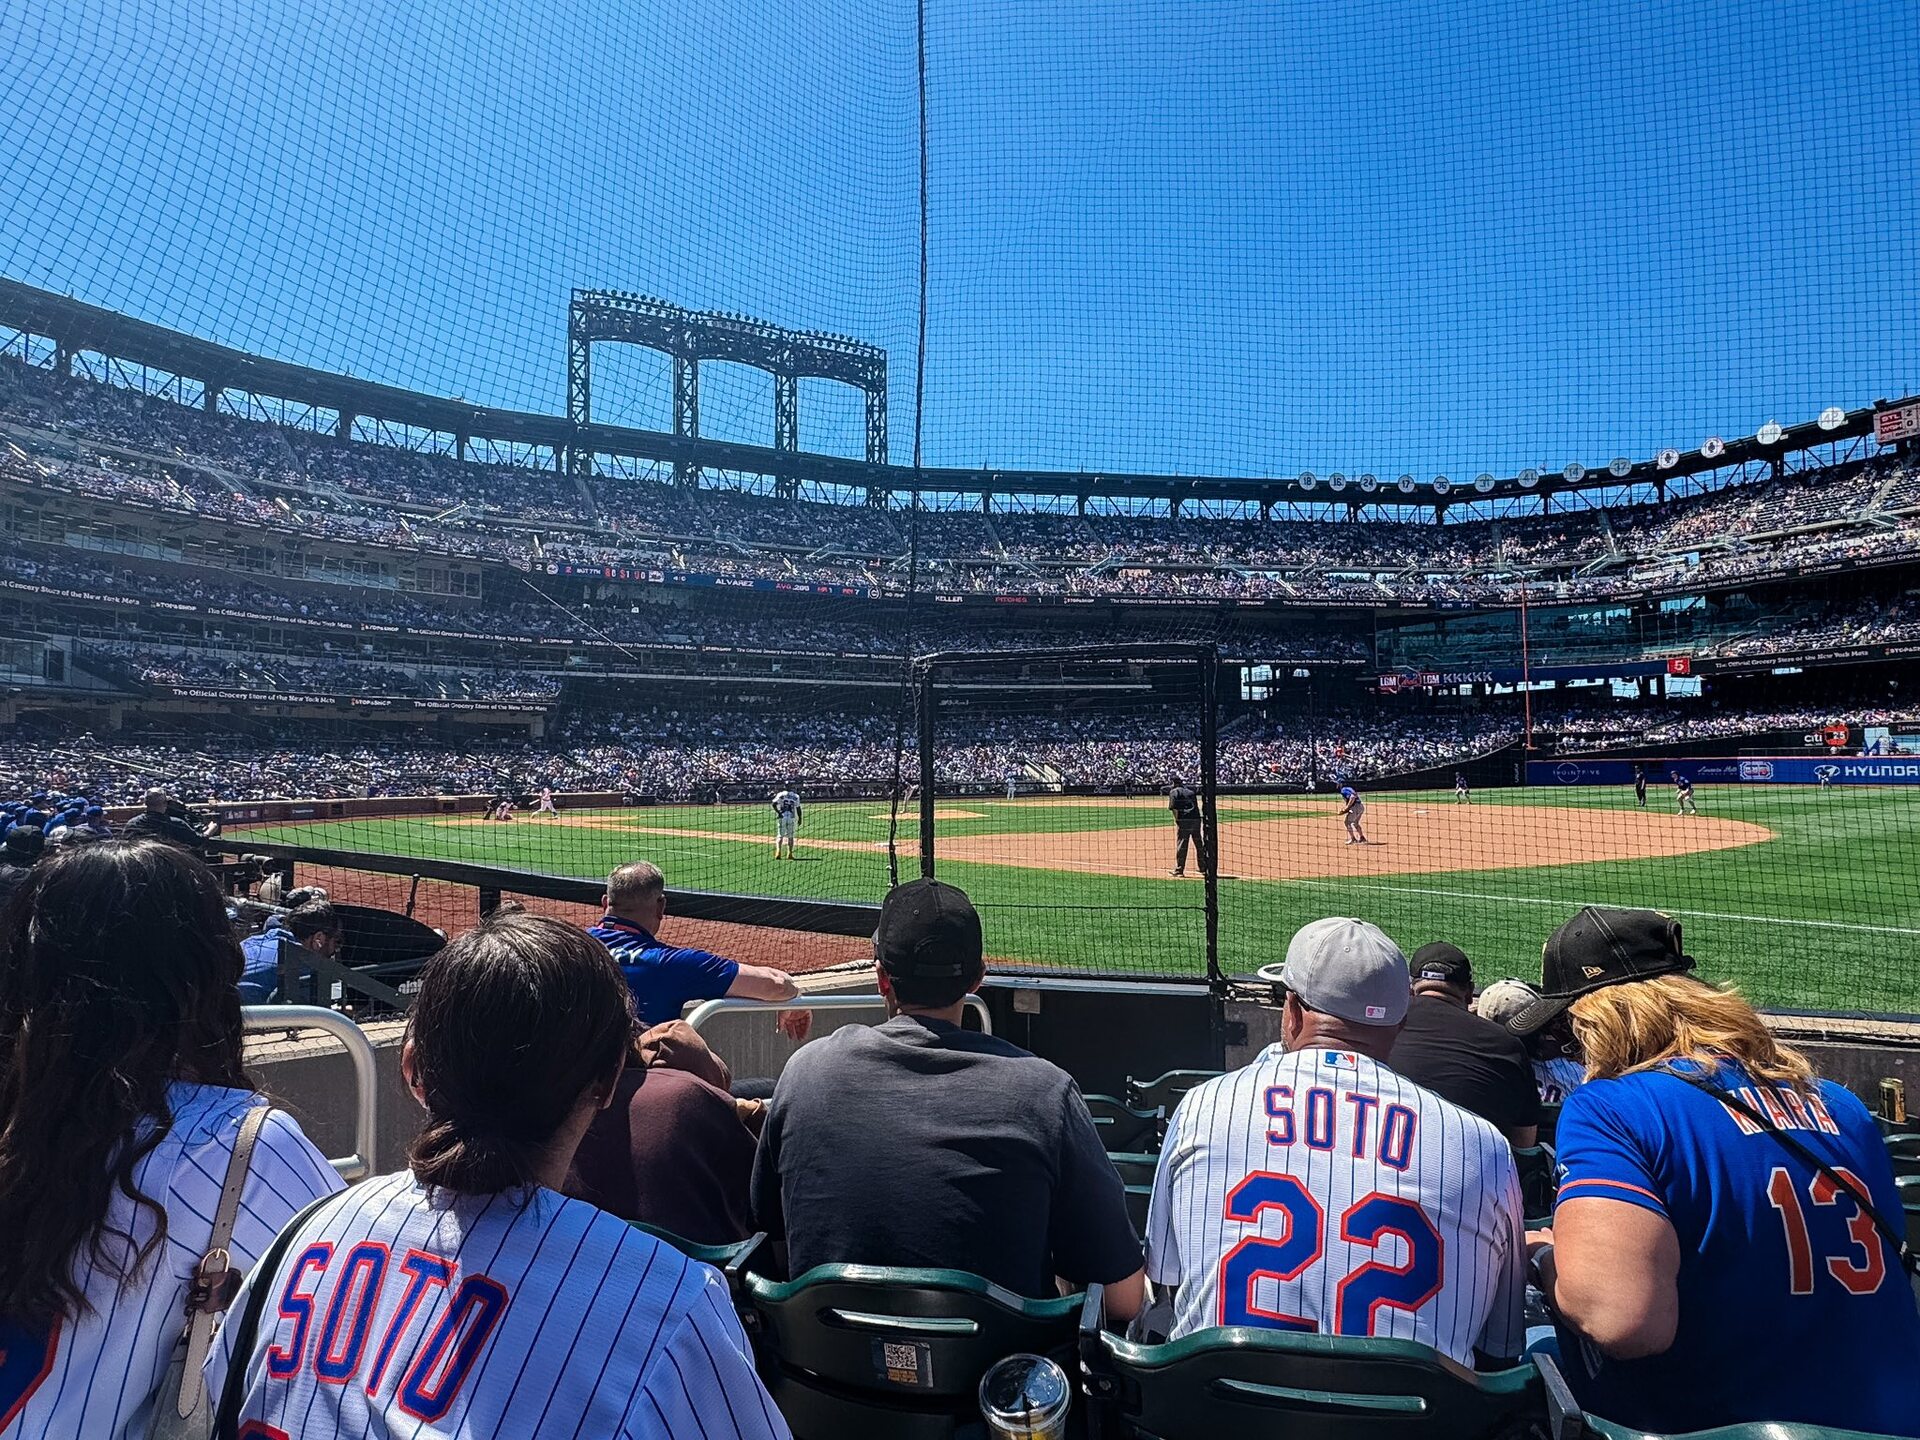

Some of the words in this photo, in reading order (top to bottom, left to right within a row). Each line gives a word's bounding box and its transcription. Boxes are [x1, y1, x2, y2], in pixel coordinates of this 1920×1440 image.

[1568, 468, 1579, 477] 14
[1614, 463, 1626, 472] 37
[1303, 476, 1312, 486] 18
[1333, 477, 1342, 486] 16
[1364, 478, 1374, 488] 24
[1402, 479, 1410, 488] 17
[1437, 481, 1446, 490] 36
[715, 578, 754, 587] ALVAREZ
[935, 594, 963, 602] KELLER
[1674, 658, 1684, 672] 5
[1380, 676, 1396, 686] LGM
[1423, 674, 1440, 684] LGM
[1832, 731, 1846, 740] 25
[1264, 1085, 1418, 1172] SOTO
[1766, 1166, 1886, 1295] 13
[1218, 1170, 1444, 1337] 22
[267, 1240, 510, 1424] SOTO
